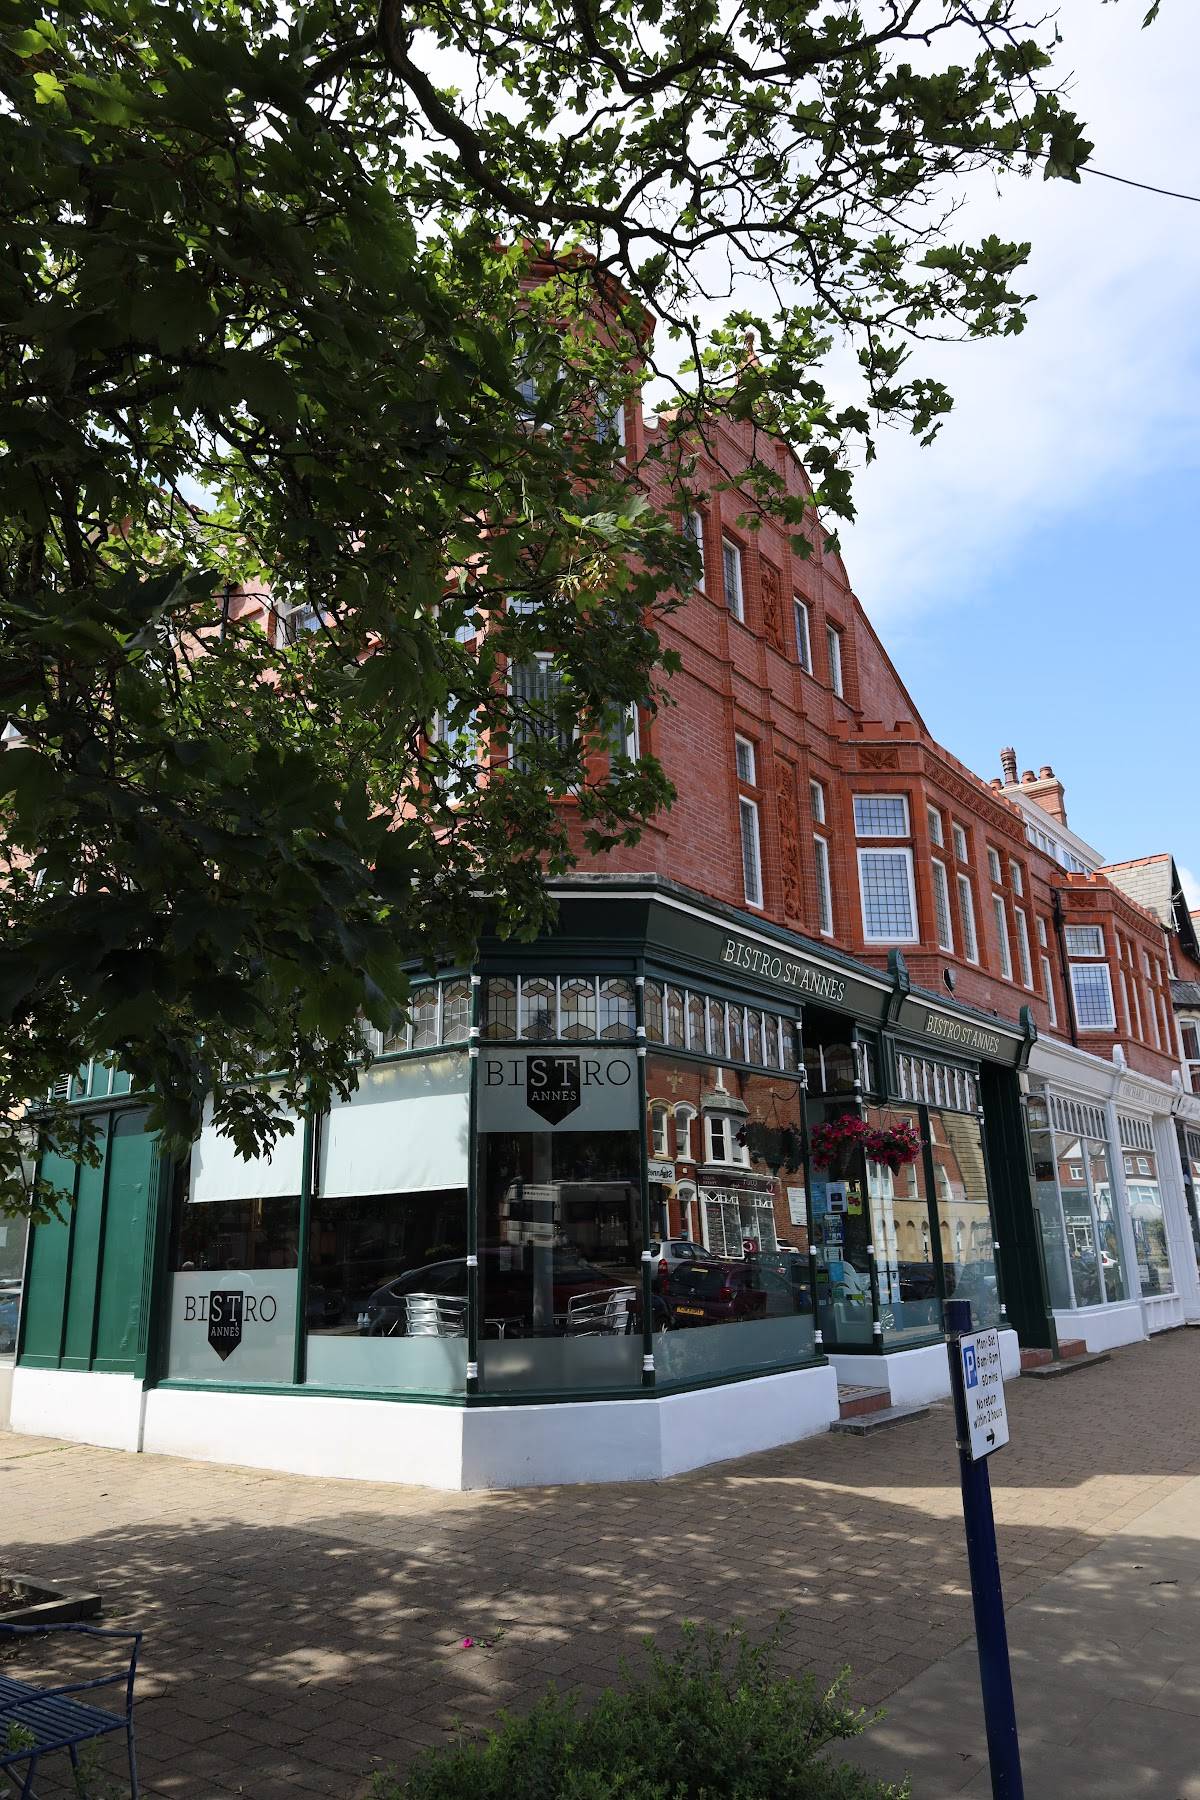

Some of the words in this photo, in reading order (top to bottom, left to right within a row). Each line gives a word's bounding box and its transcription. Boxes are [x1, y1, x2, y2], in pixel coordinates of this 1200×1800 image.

[723, 939, 782, 979] BISTRO
[926, 1014, 961, 1041] BISTRO
[484, 1059, 631, 1087] BISTRO
[183, 1295, 277, 1322] BISTRO
